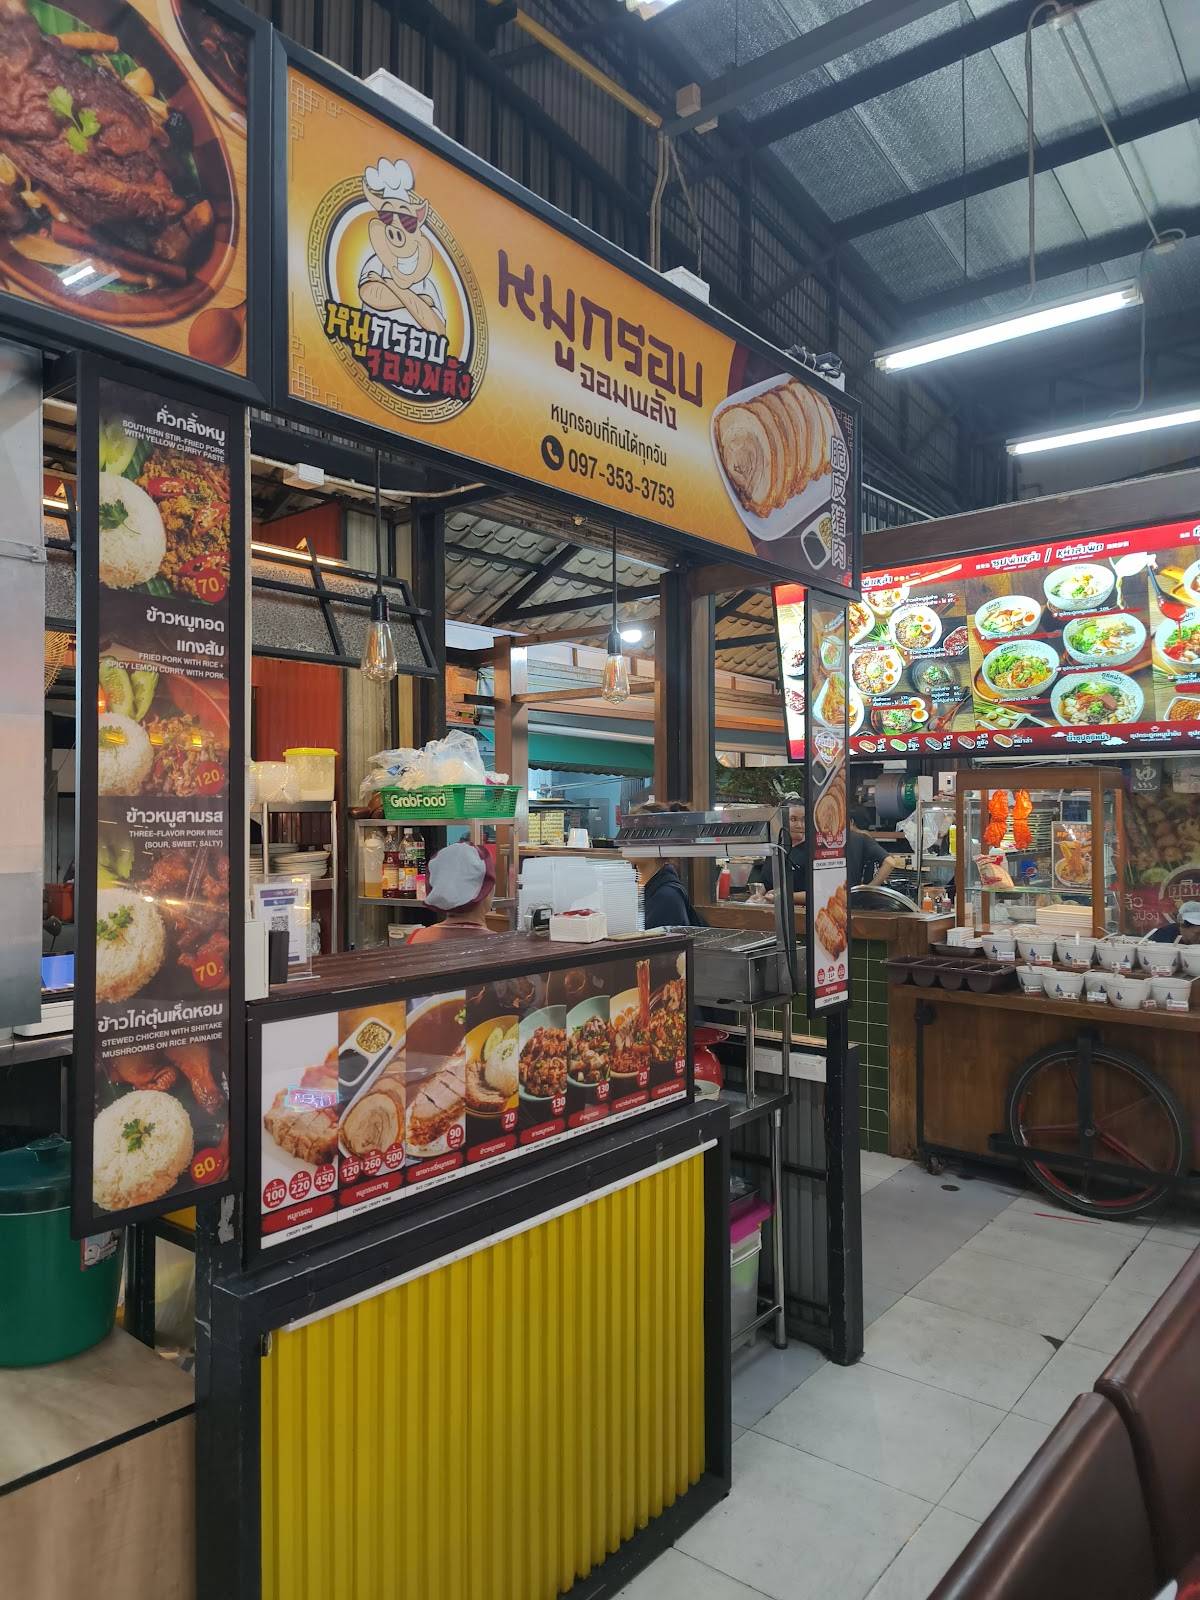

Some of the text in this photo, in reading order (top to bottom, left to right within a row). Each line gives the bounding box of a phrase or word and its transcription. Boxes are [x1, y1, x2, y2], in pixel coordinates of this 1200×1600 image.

[326, 302, 448, 365] หมูกรอบ
[498, 249, 702, 408] หมูกรอบ
[367, 347, 472, 399] จอมพลัง
[580, 362, 678, 431] จอมพลัง
[156, 404, 225, 446] คั่วกลิ้งหมู
[122, 419, 225, 456] SOUTHERN STIR-FRIED PORK
[551, 403, 667, 467] หมูกรอบที่กินได้ทุกวัน
[124, 428, 225, 463] WITH YELLOW CURRY PASTE
[568, 448, 675, 509] 097-353-3753
[147, 605, 225, 633] ข้าวหมูทอด
[176, 639, 225, 657] แกงส้ม
[139, 652, 161, 661] FRIED
[162, 654, 183, 664] PORK
[183, 657, 201, 666] WITH
[202, 660, 219, 669] RICE
[131, 662, 158, 673] LEMON
[159, 665, 185, 675] CURRY
[186, 667, 205, 677] WITH
[205, 670, 225, 680] PORK
[390, 793, 446, 808] GrabFood
[126, 807, 224, 828] ข้าวหมูสามรส
[129, 830, 185, 838] THREE-FLAVOR
[144, 839, 223, 849] (SOUR, SWEET, SALTY)
[97, 1003, 223, 1033] ข้าวไก่ตุ๋นเห็ดหอม
[101, 1021, 223, 1047] STEWED CHICKEN WITH SHIITAKE
[102, 1043, 155, 1058] MUSHROOMS
[156, 1040, 168, 1049] ON
[169, 1037, 187, 1047] RICE
[674, 1059, 686, 1070] 130
[640, 1071, 648, 1081] 70
[597, 1083, 609, 1094] 130
[552, 1096, 566, 1108] 130
[504, 1112, 516, 1124] 70
[449, 1127, 462, 1139] 90
[364, 1158, 381, 1171] 260
[386, 1151, 403, 1164] 500
[315, 1173, 334, 1186] 450
[342, 1165, 360, 1178] 120
[265, 1188, 285, 1202] 100
[291, 1180, 310, 1195] 220
